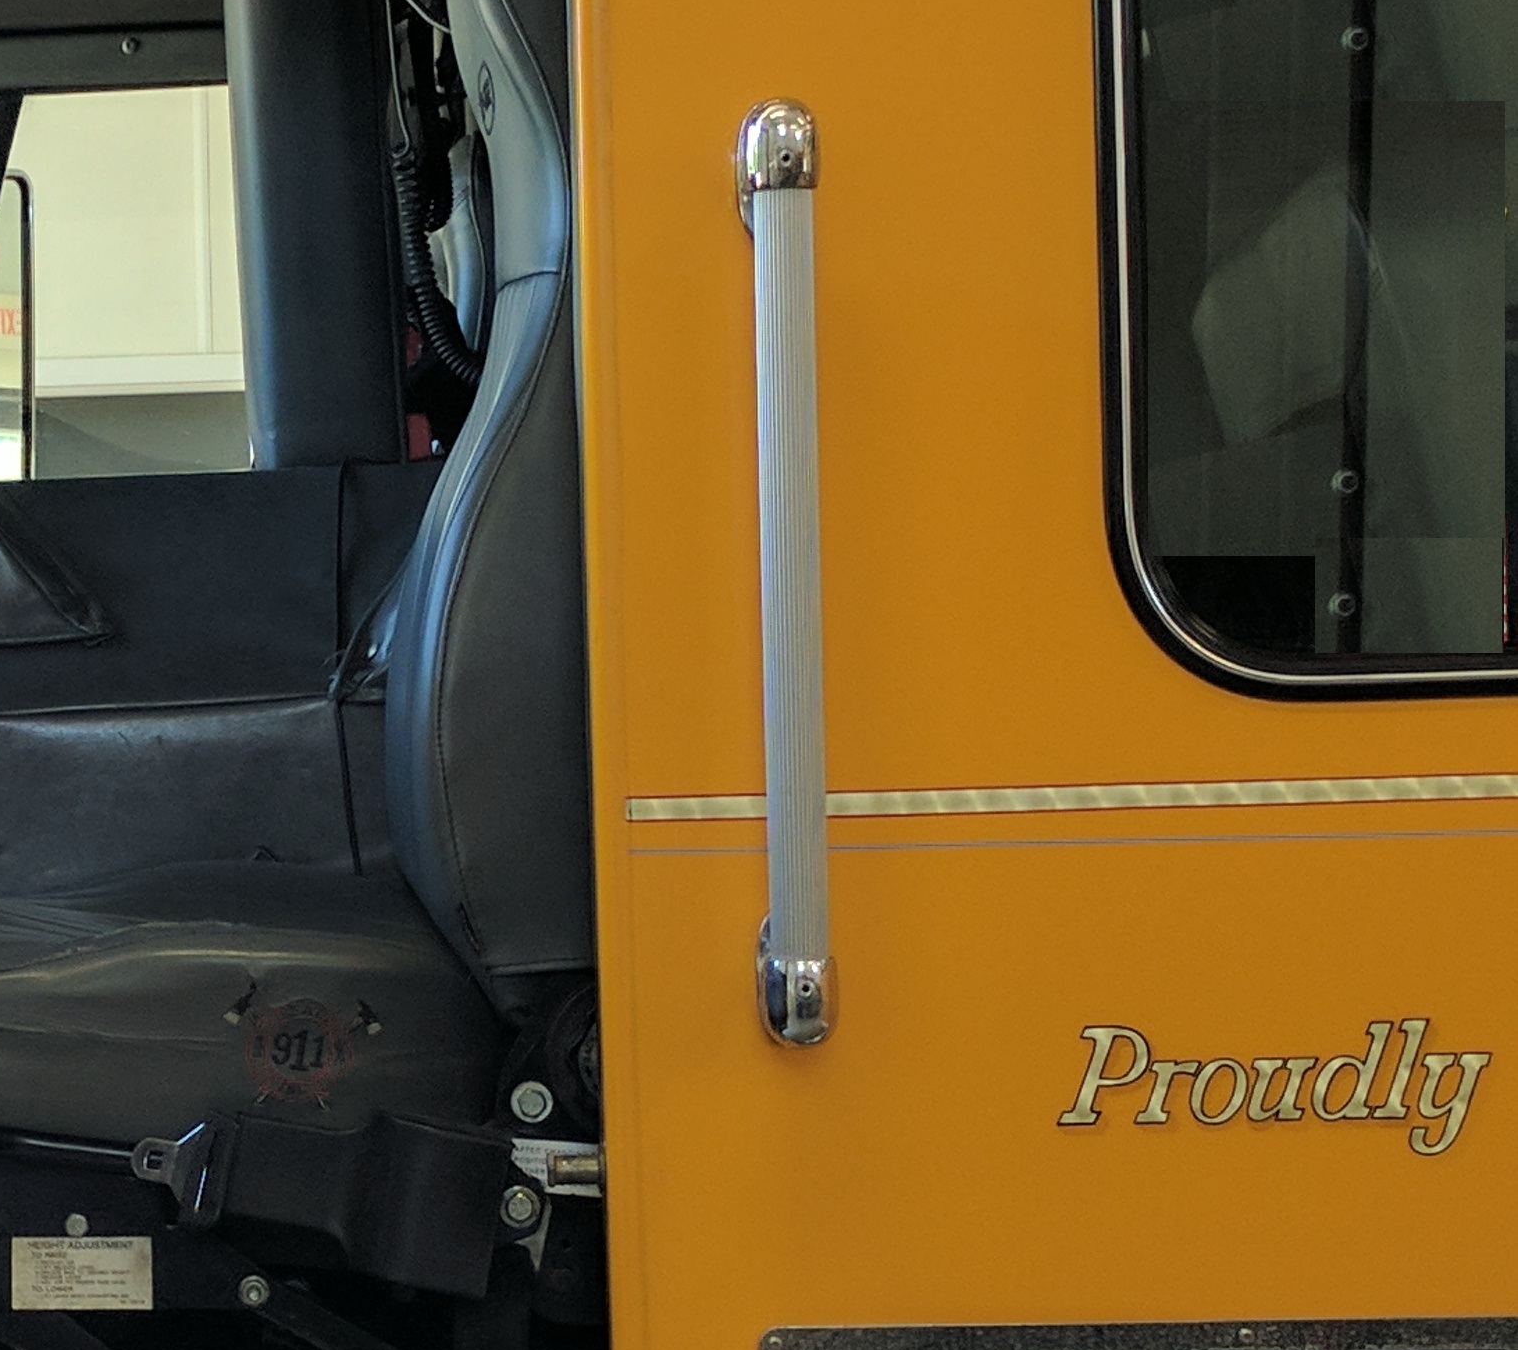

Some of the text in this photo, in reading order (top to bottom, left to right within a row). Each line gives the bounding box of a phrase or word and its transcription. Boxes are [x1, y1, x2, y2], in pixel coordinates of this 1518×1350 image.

[271, 1030, 325, 1072] 911
[1057, 1018, 1493, 1156] Proudly
[67, 1240, 134, 1250] ADJUSTMENT
